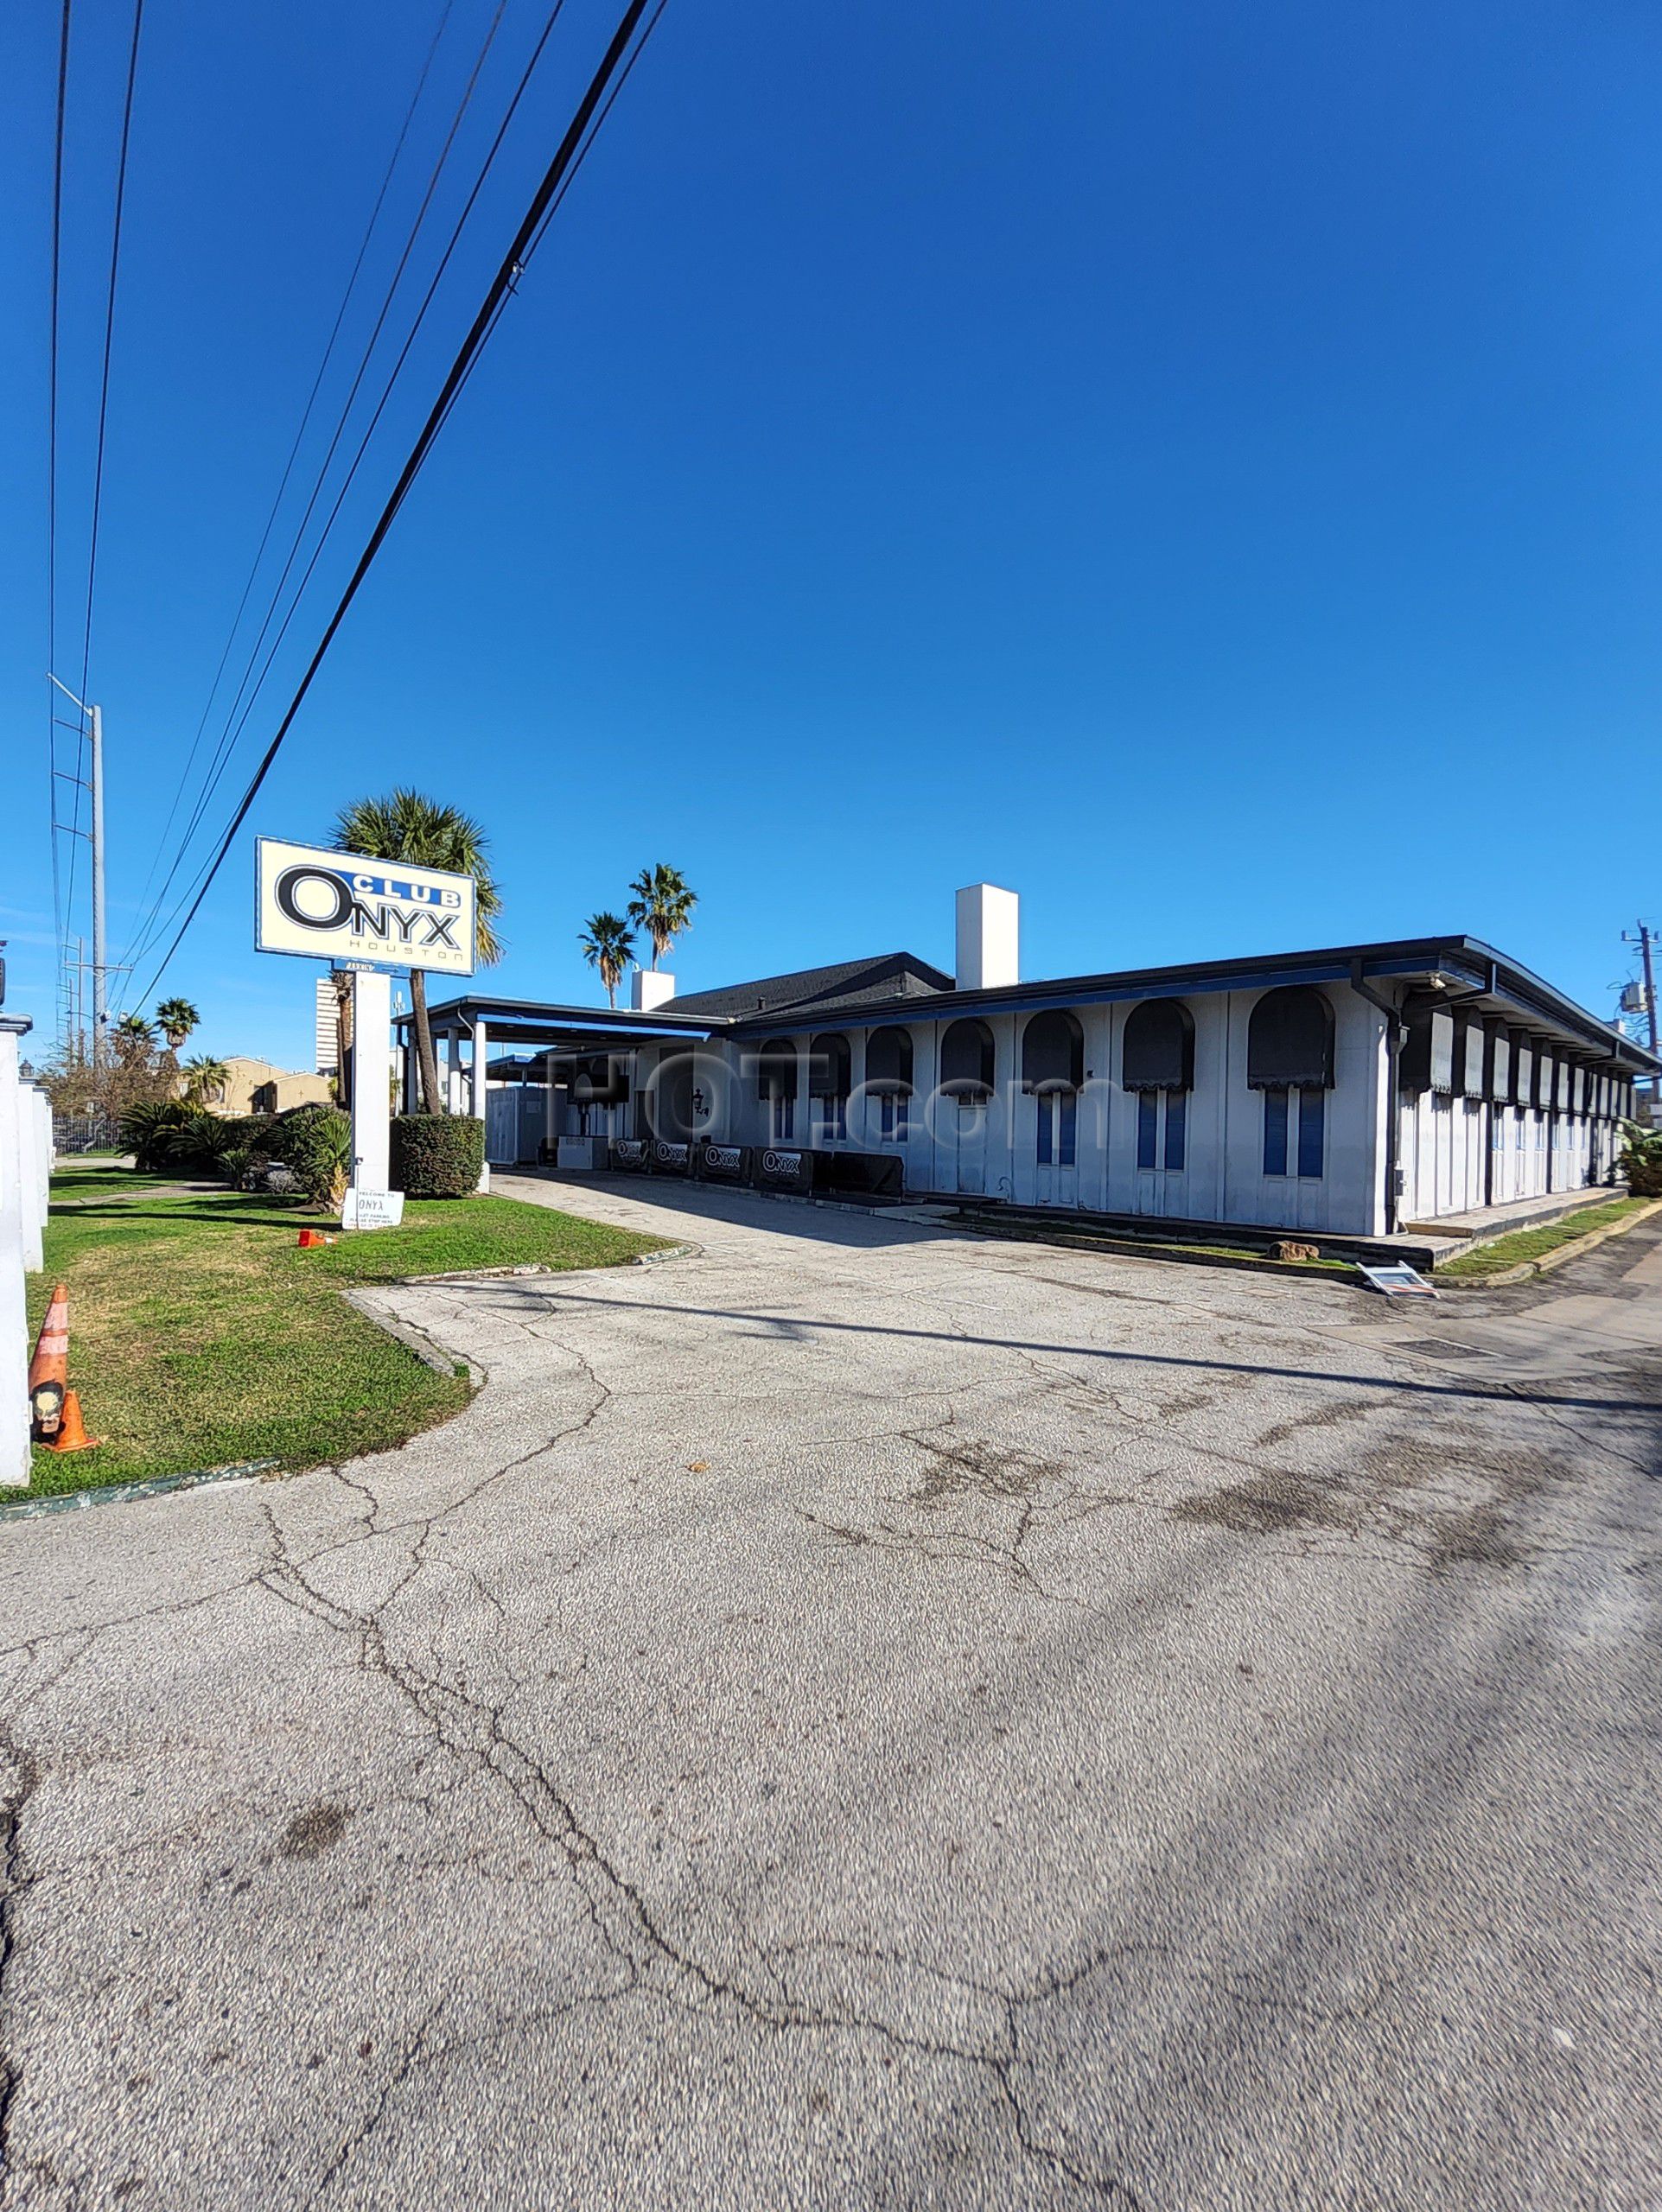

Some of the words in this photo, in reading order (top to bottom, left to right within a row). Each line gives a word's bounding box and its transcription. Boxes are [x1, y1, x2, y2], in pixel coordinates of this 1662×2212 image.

[352, 874, 462, 909] CLUB
[274, 864, 462, 950] ONYX
[705, 1146, 741, 1168] ONYX
[762, 1150, 801, 1174] ONYX
[359, 1198, 384, 1211] ONYX
